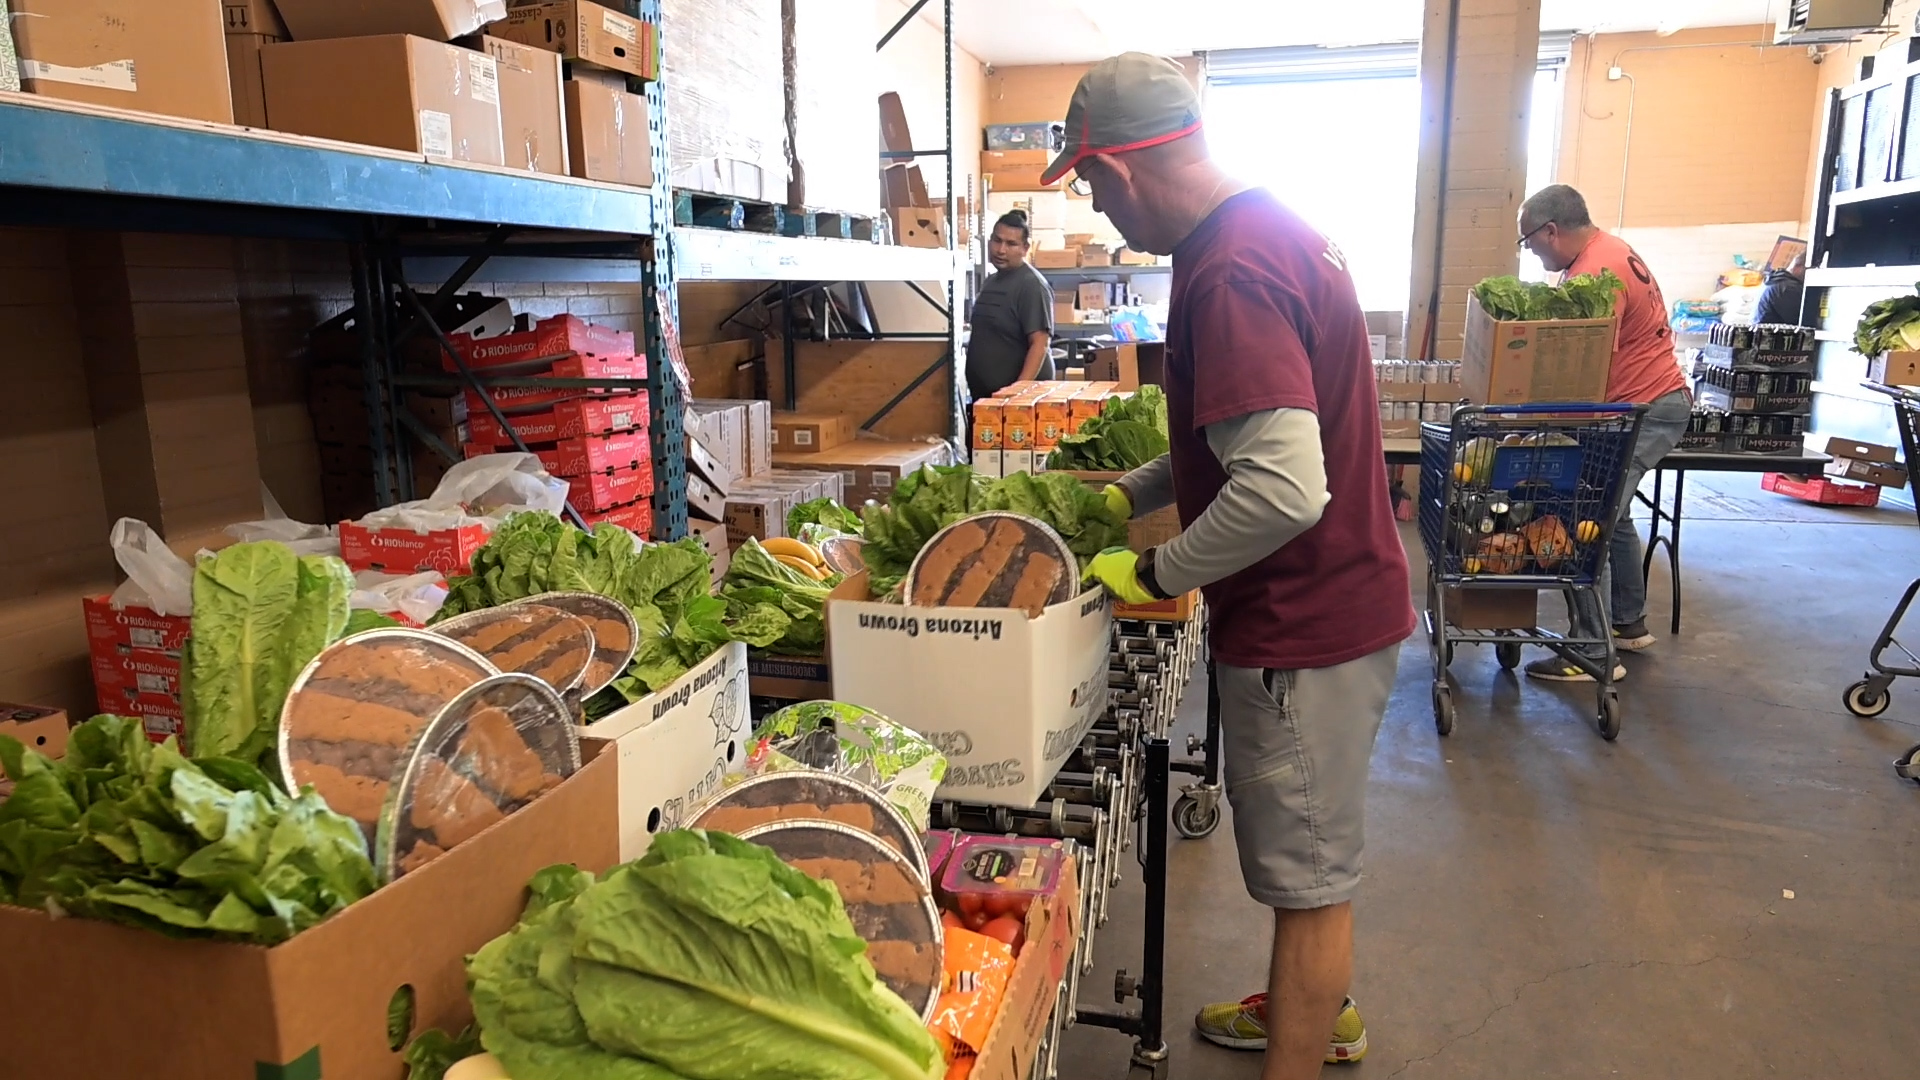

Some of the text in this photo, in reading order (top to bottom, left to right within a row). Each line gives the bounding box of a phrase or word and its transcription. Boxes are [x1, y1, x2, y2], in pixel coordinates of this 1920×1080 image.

[509, 7, 542, 21] classic
[580, 15, 588, 56] classic
[488, 342, 534, 357] RIOblanco
[384, 537, 424, 549] RIOblanco
[130, 616, 171, 629] RIOblanco
[859, 612, 1003, 640] Arizona Grown
[136, 661, 178, 675] RIOblanco
[761, 662, 817, 678] MUSHROOMS
[652, 655, 728, 722] Arizona Grown
[896, 784, 931, 807] GREEN
